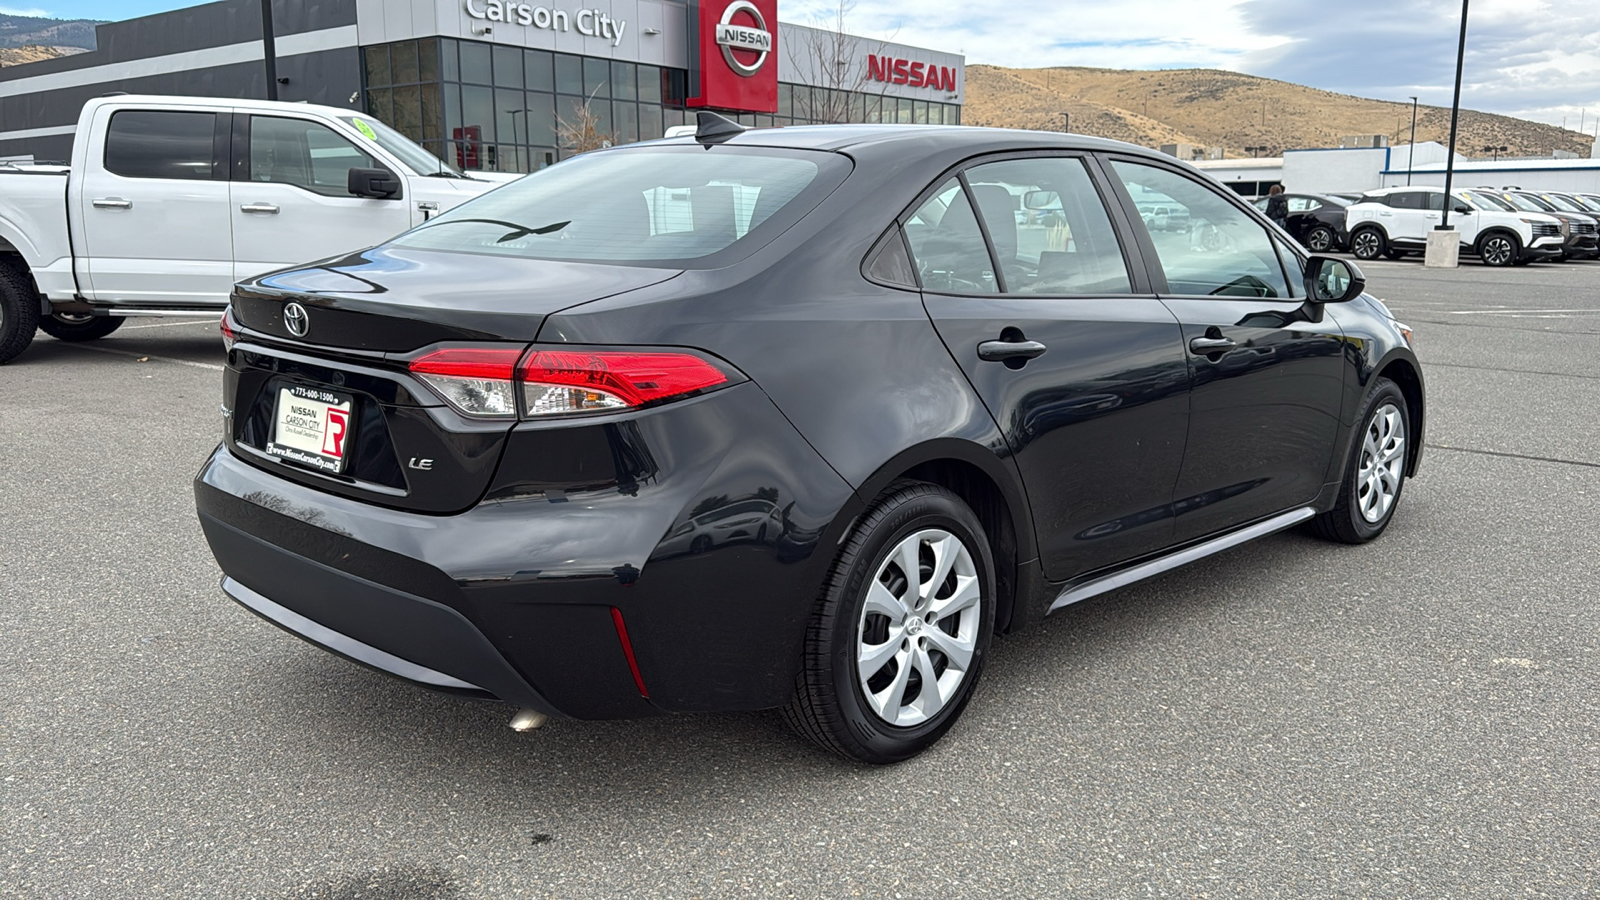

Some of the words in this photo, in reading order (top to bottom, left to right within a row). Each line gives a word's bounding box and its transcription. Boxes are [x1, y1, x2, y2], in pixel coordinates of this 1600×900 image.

[467, 0, 569, 32] Carson
[576, 9, 626, 47] City
[724, 29, 770, 47] NISSAN
[867, 54, 956, 92] NISSAN
[295, 387, 334, 402] 775-600-1500
[291, 405, 317, 418] NISSAN
[285, 415, 308, 427] CARSON
[309, 420, 321, 430] CITY
[408, 458, 434, 471] LE
